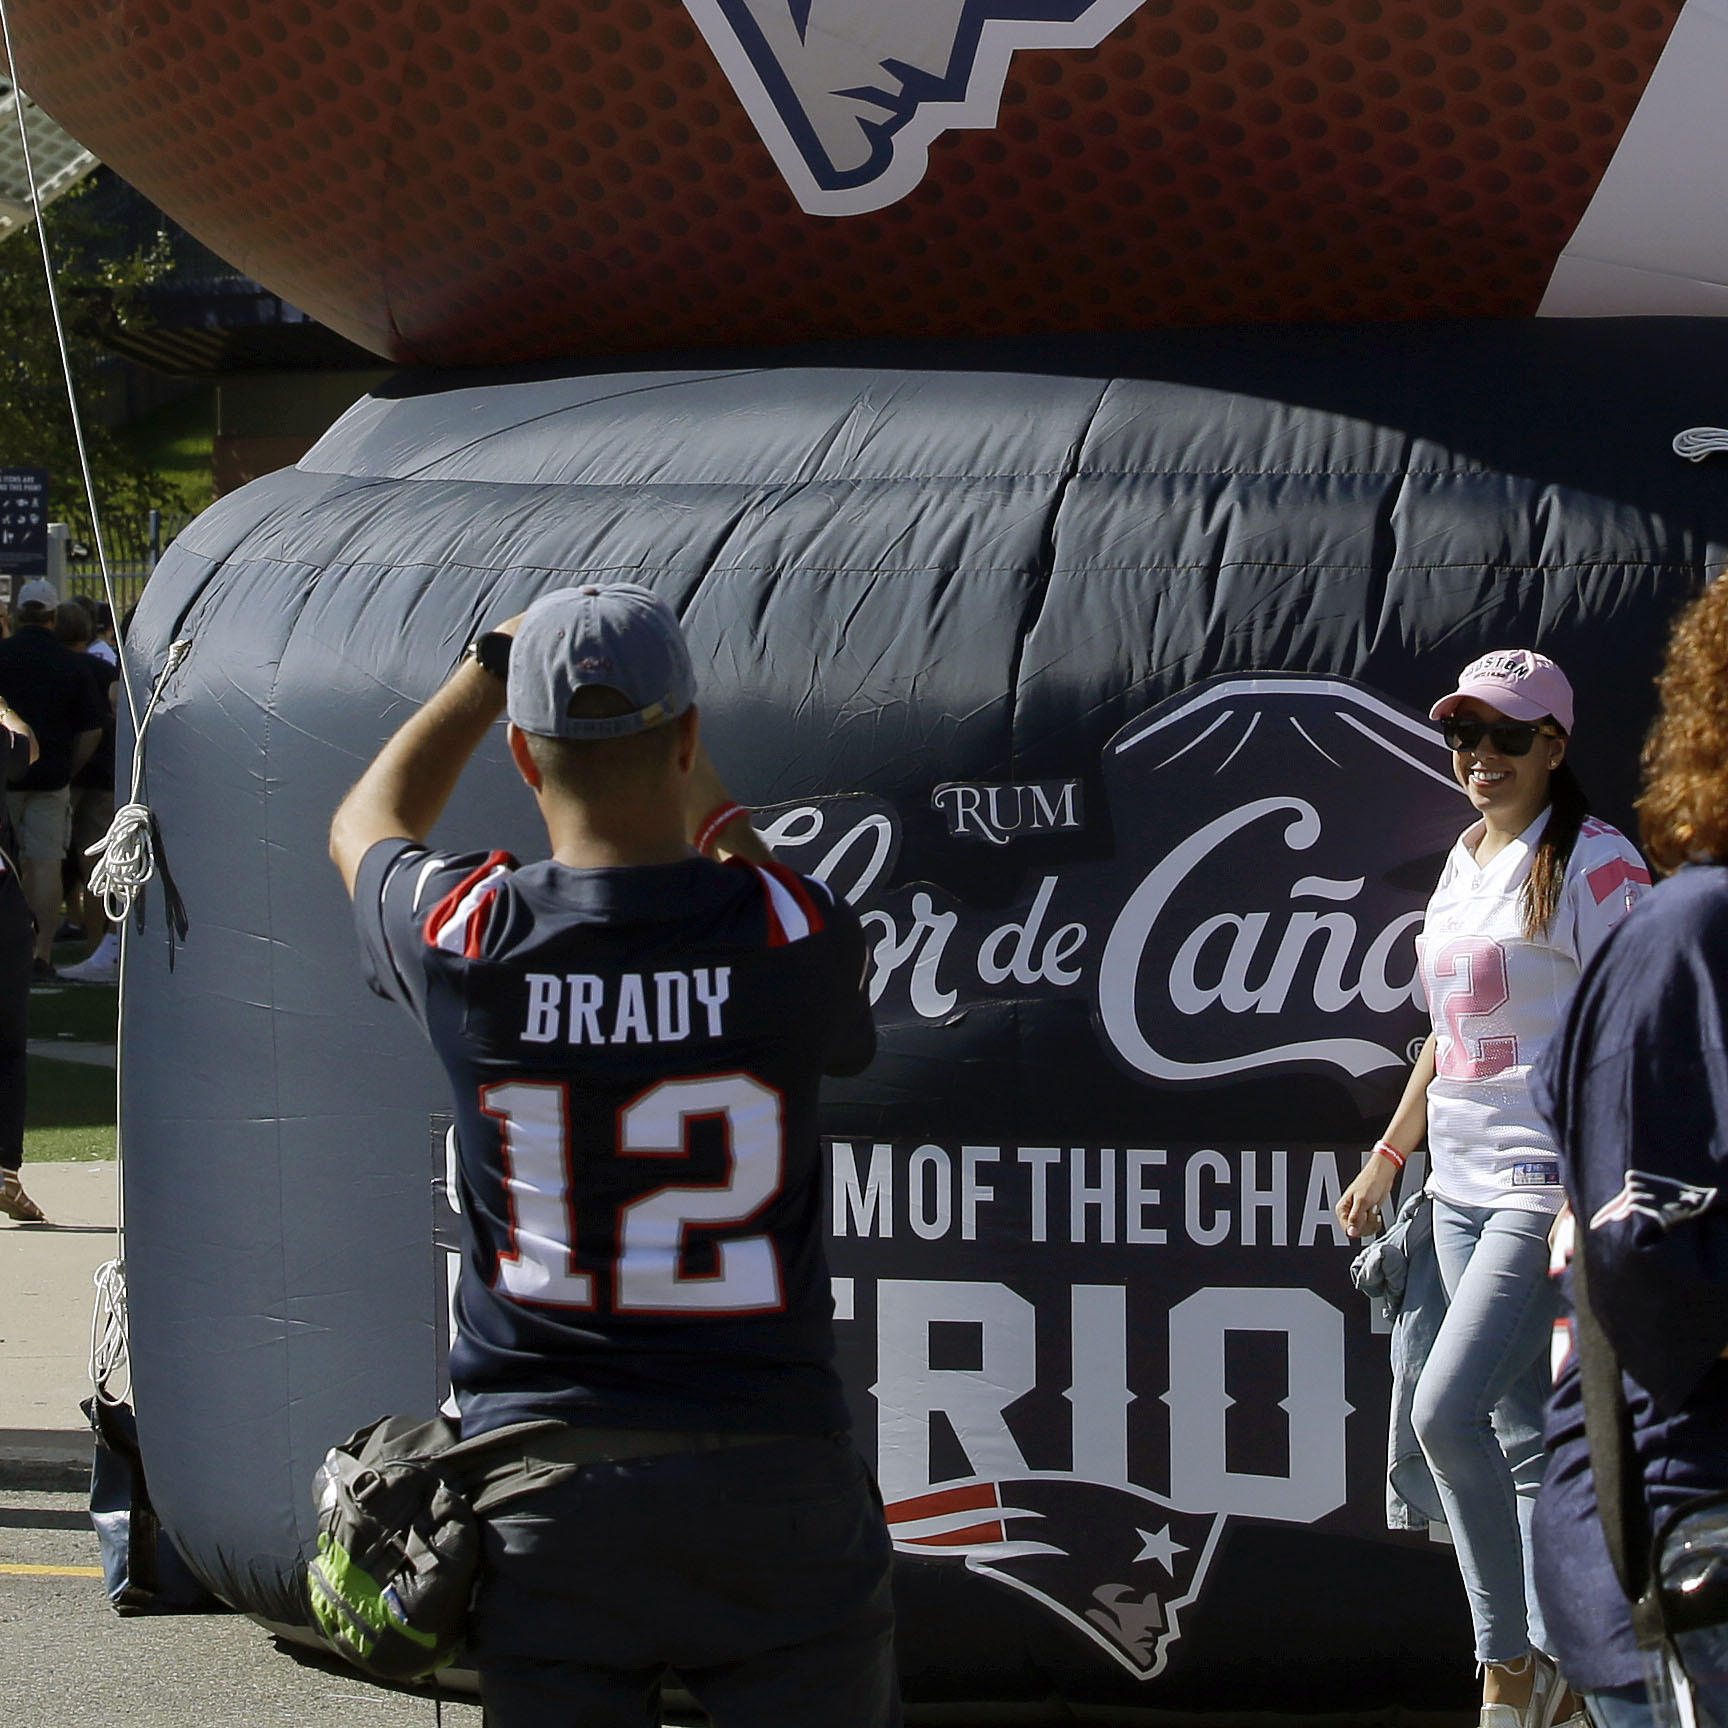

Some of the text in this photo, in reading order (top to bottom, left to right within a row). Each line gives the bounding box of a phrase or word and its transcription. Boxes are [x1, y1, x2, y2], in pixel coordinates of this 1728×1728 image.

[933, 782, 1080, 844] RUM
[977, 876, 1088, 987] de
[1098, 796, 1429, 1080] Caña
[520, 965, 733, 1046] BRADY
[479, 1072, 788, 1316] 12
[910, 1144, 1004, 1242] OF
[1016, 1146, 1167, 1246] THE
